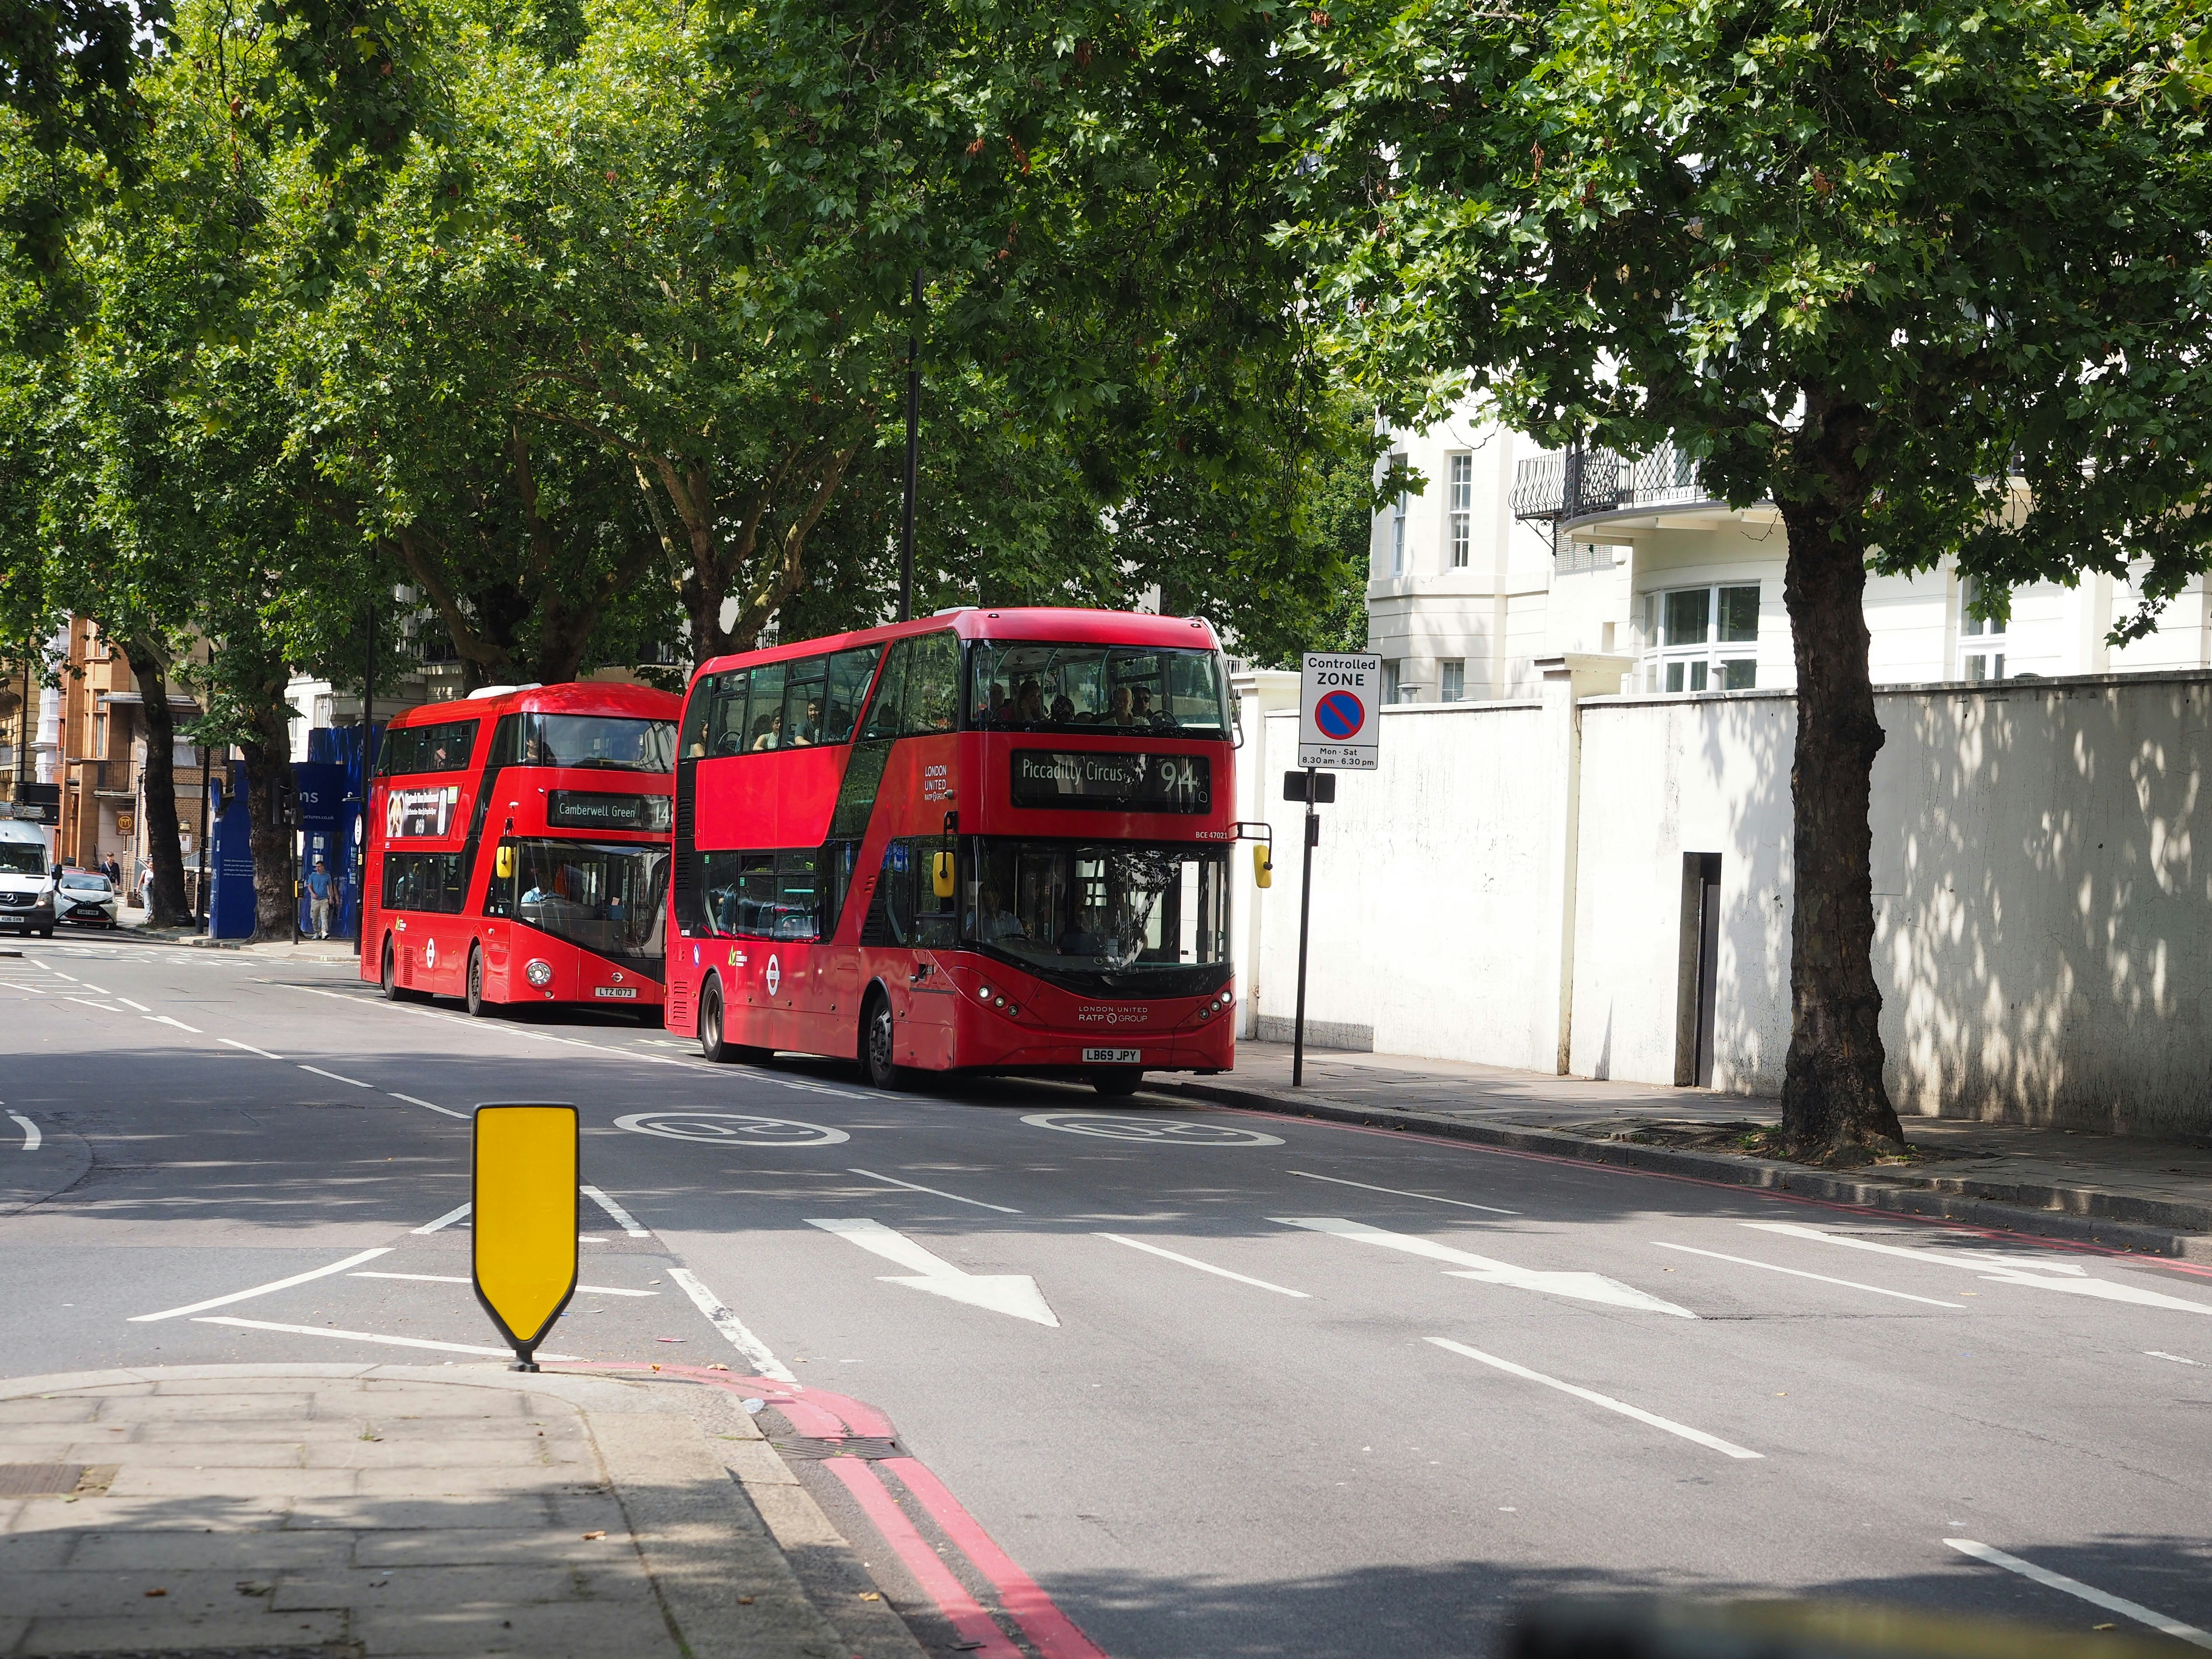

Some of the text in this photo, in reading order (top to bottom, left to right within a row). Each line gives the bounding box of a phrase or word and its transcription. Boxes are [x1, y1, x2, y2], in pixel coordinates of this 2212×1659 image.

[1308, 657, 1375, 670] Controlled
[1317, 672, 1364, 686] ZONE
[925, 765, 947, 777] LONDON
[1023, 758, 1197, 793] Piccadilly Circus 94
[925, 779, 946, 791] UNITED
[559, 801, 673, 824] Camberwell Green 14
[1086, 1049, 1136, 1061] LB69 JPY
